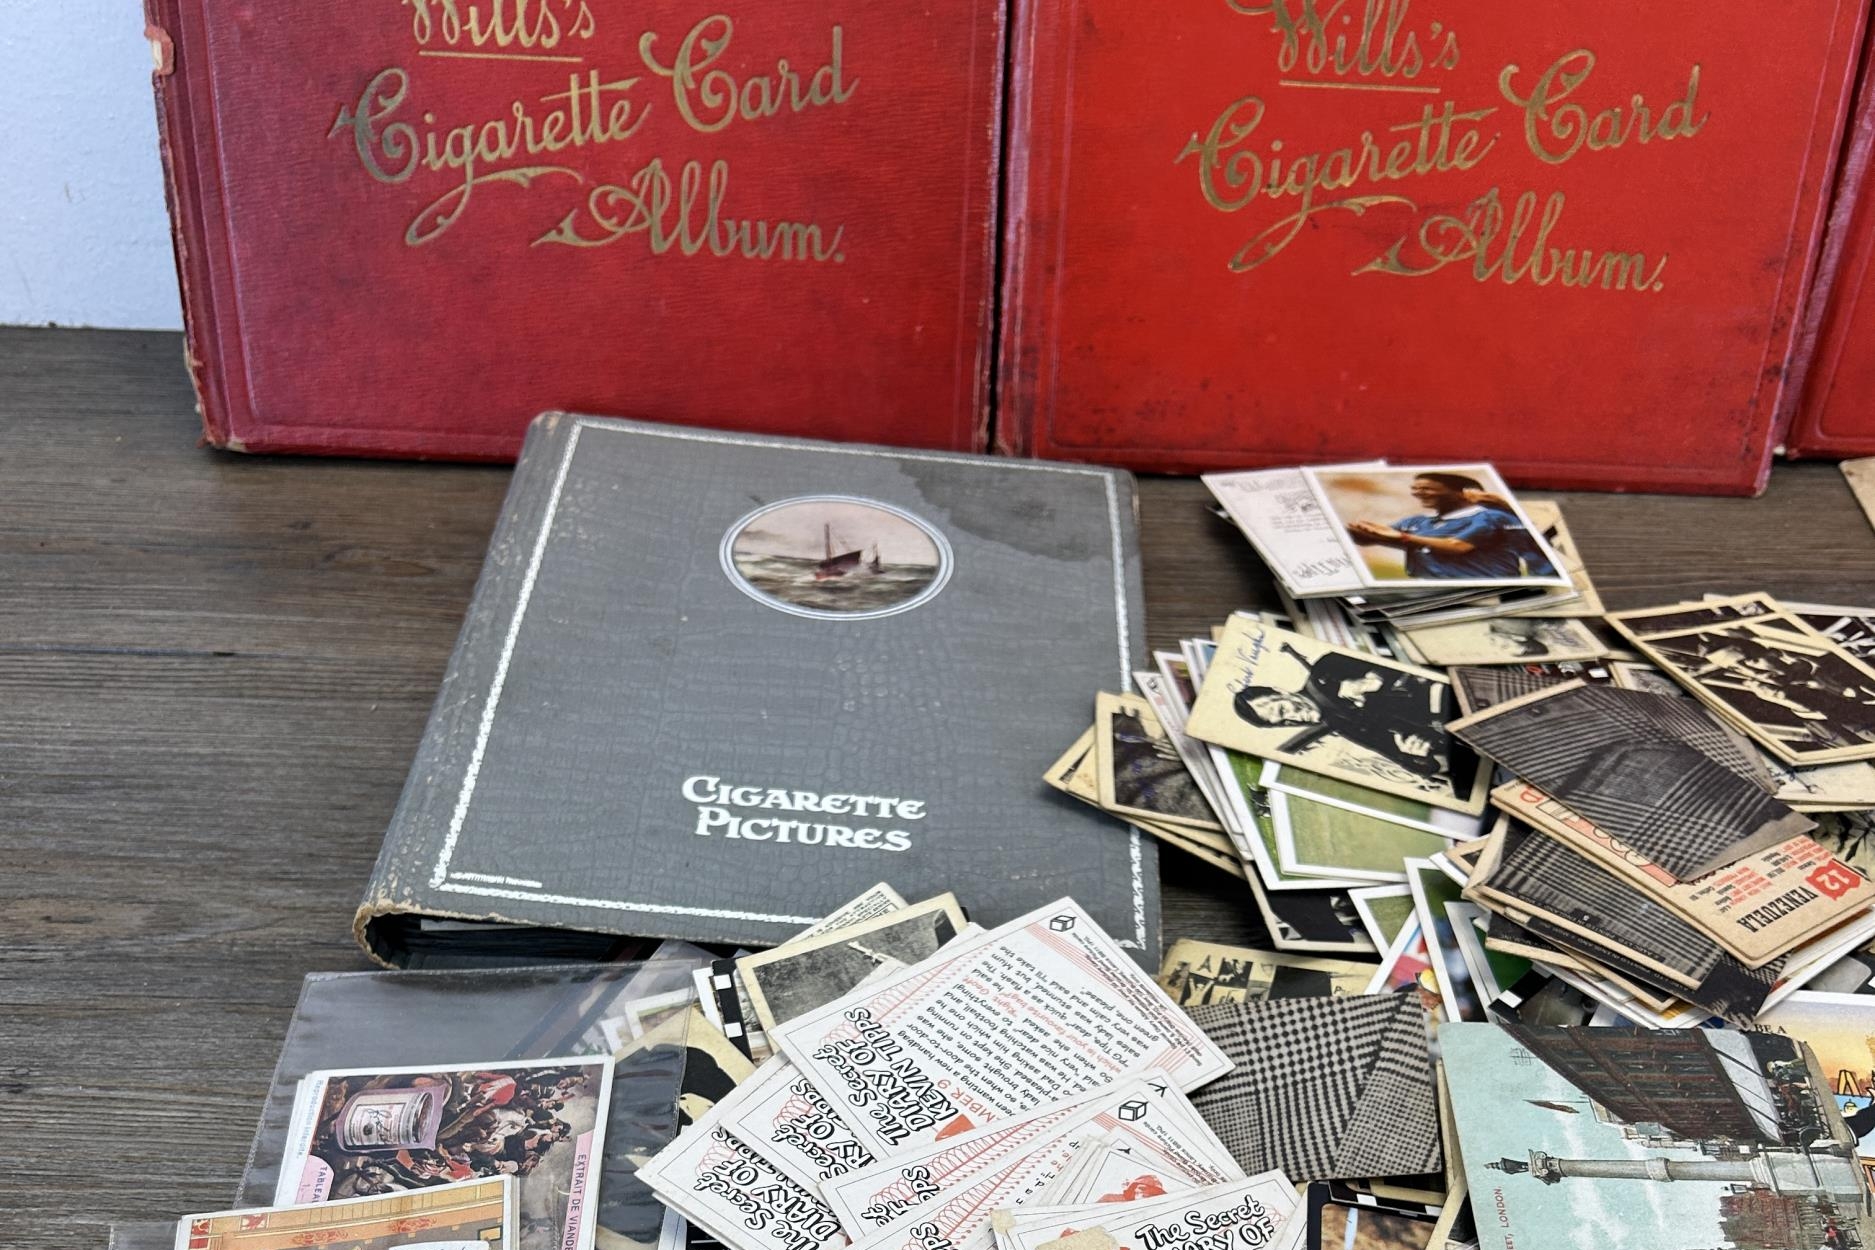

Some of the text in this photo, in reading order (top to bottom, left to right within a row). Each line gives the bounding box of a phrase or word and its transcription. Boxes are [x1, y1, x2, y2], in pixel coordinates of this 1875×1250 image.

[1229, 0, 1460, 76] Wills's
[327, 15, 860, 245] Cigarette Card
[1174, 48, 1711, 271] Cigarette Card
[531, 158, 846, 263] Album.
[1352, 188, 1665, 292] Album.
[695, 806, 912, 852] PICTURES
[1819, 868, 1851, 891] 12
[1736, 886, 1819, 933] VENEZUELA
[834, 1038, 936, 1132] DIARY OF
[844, 1008, 958, 1122] KEVIN TIPPS
[918, 1016, 1040, 1106] lady brought some, she was
[790, 1108, 834, 1140] OF
[812, 1044, 910, 1146] The Secret
[571, 1153, 588, 1195] EXTRAIT
[770, 1124, 852, 1180] Secret
[312, 1166, 328, 1203] TABLEA
[571, 1199, 581, 1212] DE
[694, 1172, 777, 1230] Secret
[712, 1160, 842, 1242] DIARY OF
[1135, 1195, 1265, 1250] The Secret
[1240, 1218, 1275, 1247] OF
